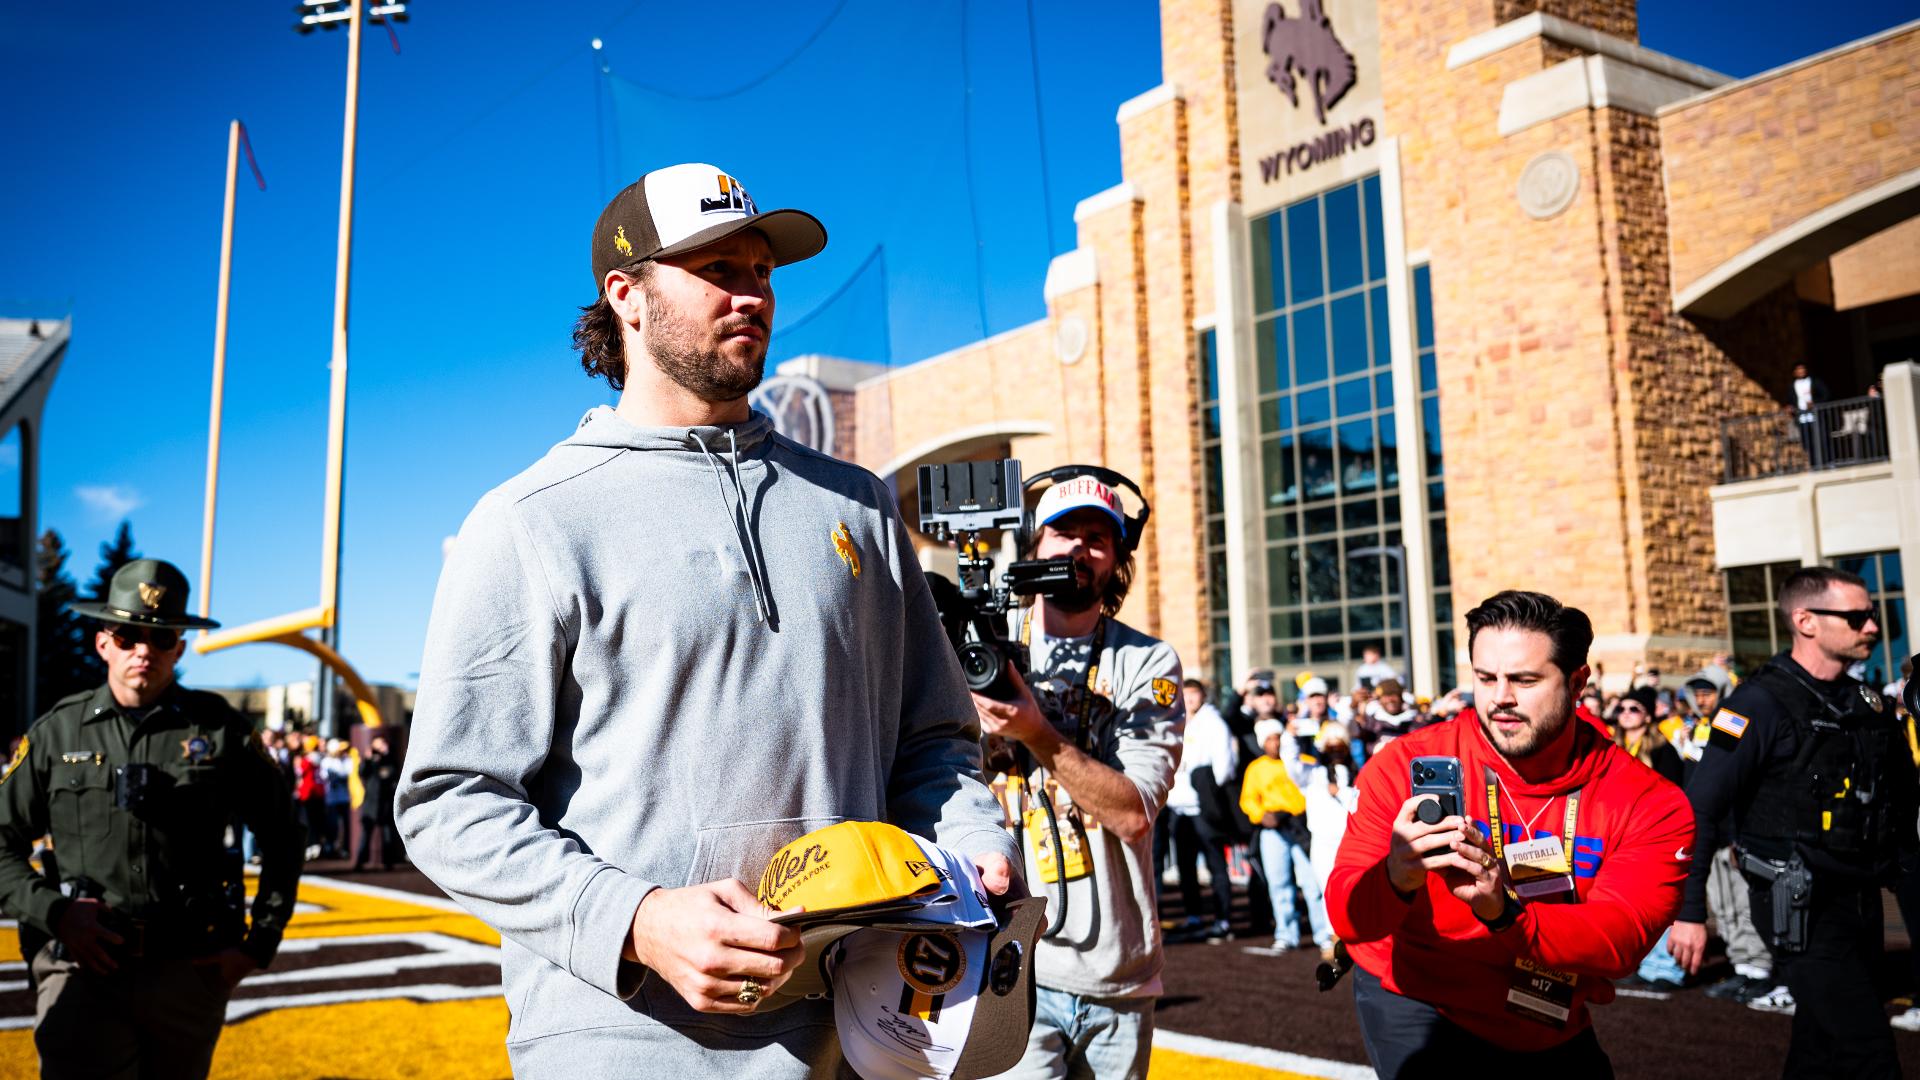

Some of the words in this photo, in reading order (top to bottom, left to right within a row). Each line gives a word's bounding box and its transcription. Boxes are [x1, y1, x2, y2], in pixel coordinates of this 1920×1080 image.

[1259, 118, 1375, 183] WYOMING
[1059, 480, 1116, 511] BUFFALO
[1512, 847, 1558, 862] FOOTBALL
[913, 936, 950, 981] 17
